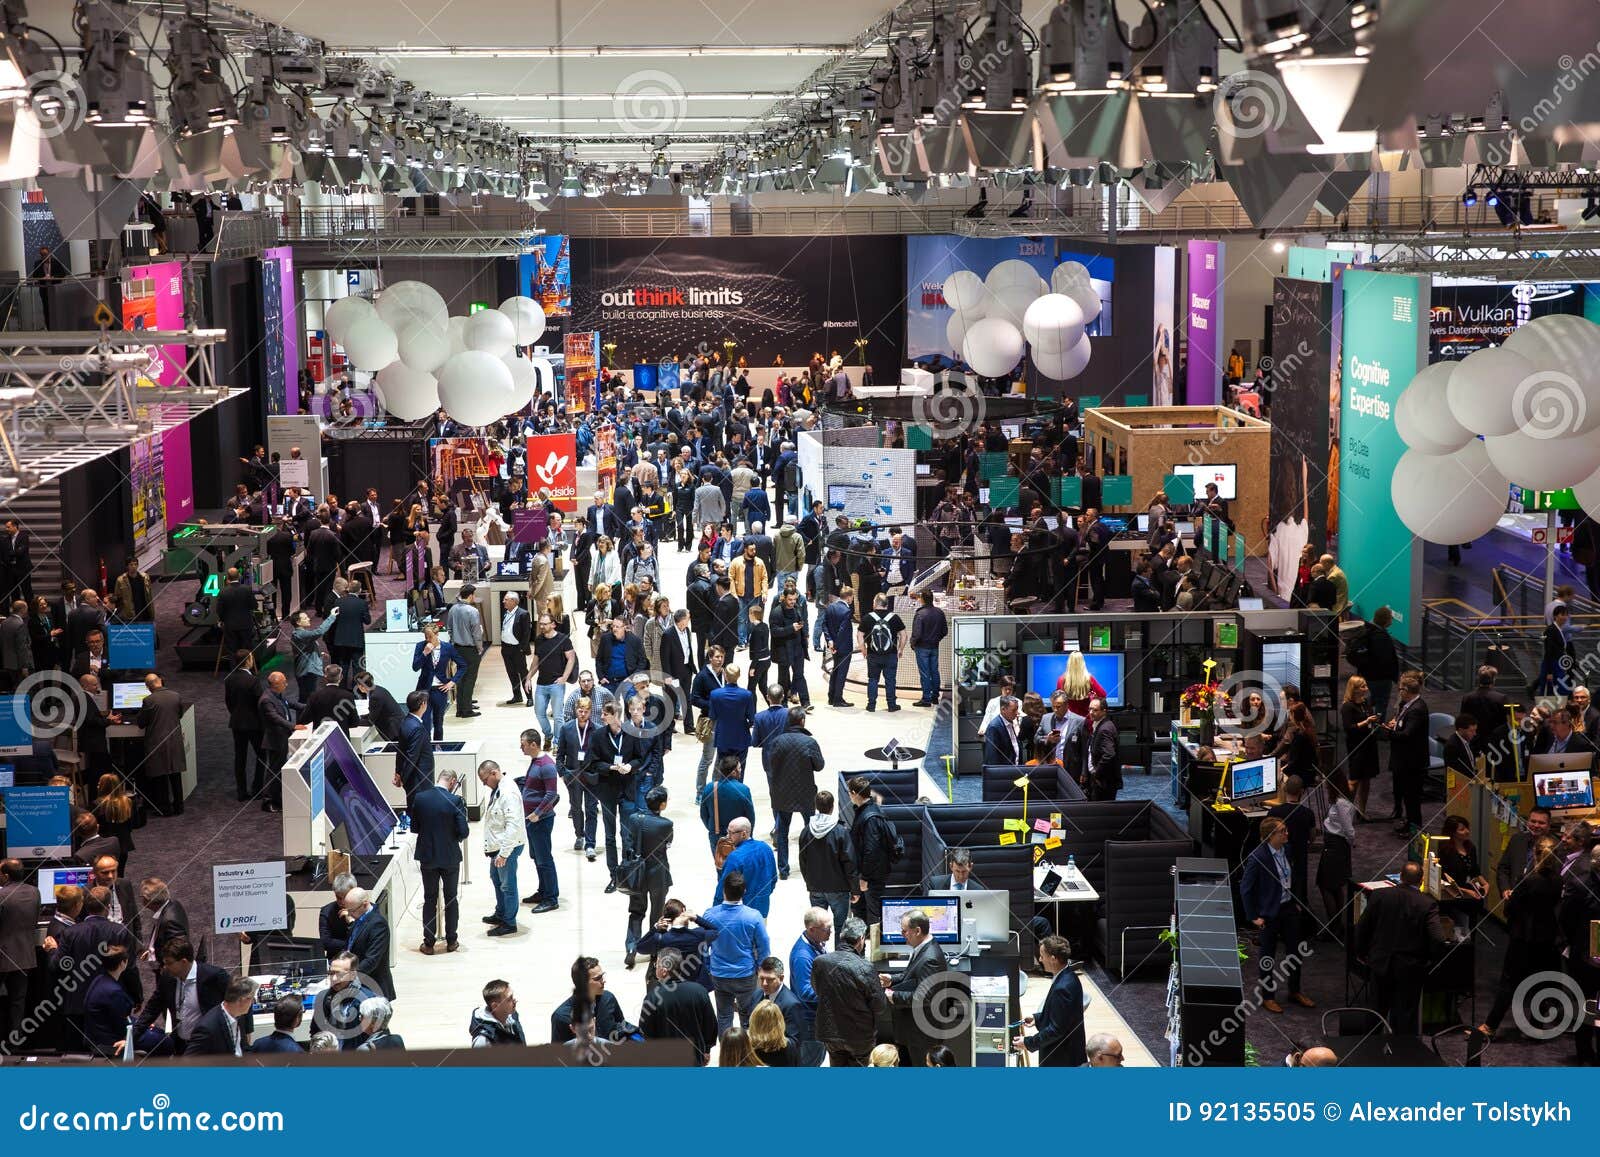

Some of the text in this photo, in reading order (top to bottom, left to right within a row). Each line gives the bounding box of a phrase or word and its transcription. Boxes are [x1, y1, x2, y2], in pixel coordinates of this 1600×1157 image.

[1019, 243, 1046, 256] IBM
[601, 287, 743, 306] outthink limits
[602, 309, 724, 321] build a cognitive business
[1392, 296, 1412, 322] IBM
[1457, 305, 1515, 322] Vulkan
[823, 320, 859, 329] #ibmcebit
[1351, 355, 1390, 387] Cognitive
[1350, 387, 1390, 421] Expertise
[1358, 440, 1369, 457] Data
[204, 574, 220, 597] 4
[252, 881, 274, 889] Control
[232, 915, 257, 924] PROFI
